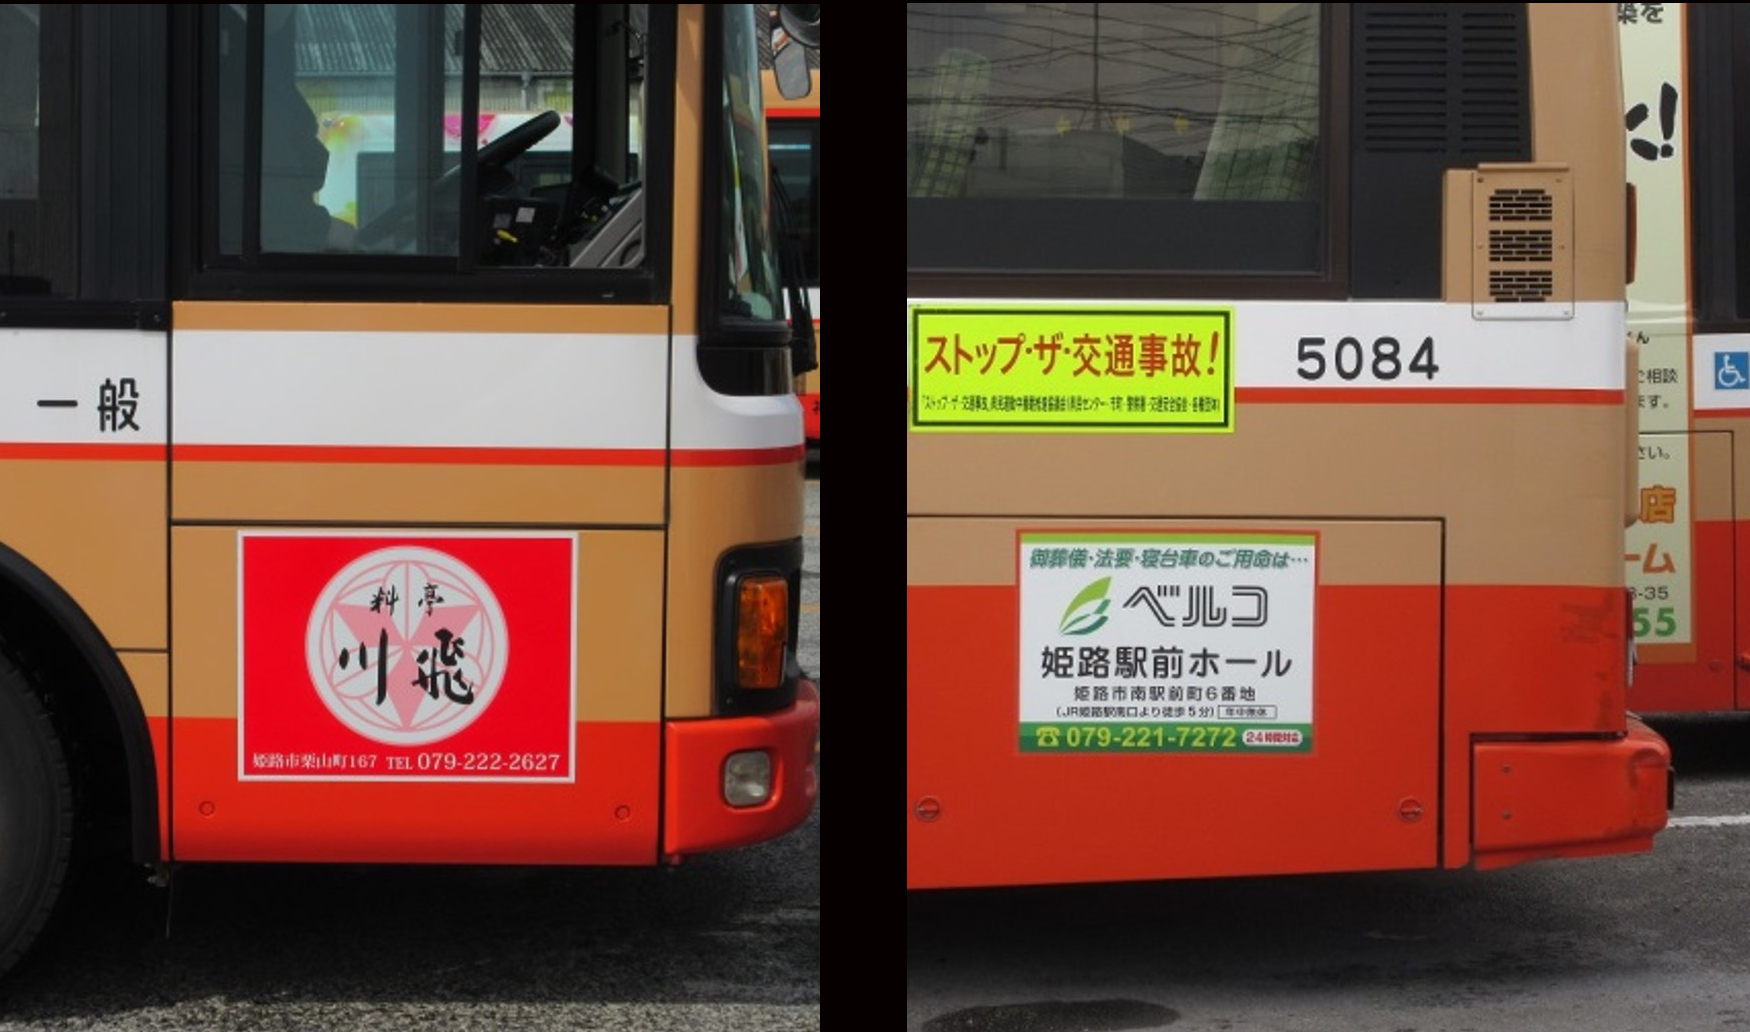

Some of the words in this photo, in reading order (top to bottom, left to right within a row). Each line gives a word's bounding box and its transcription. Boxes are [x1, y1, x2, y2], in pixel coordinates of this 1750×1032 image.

[924, 331, 1219, 377] ストップ・ザ・交通事故!
[1297, 336, 1439, 380] 5084
[37, 377, 140, 432] 一般
[1640, 484, 1677, 524] 店
[370, 583, 444, 616] 料亭
[1122, 585, 1268, 628] ベルコ
[338, 627, 475, 706] 川飛
[1041, 646, 1293, 680] 姫路駅前ホール
[1074, 685, 1257, 703] 姫路市南駅前町6番地
[1066, 727, 1237, 748] 079-221-7272
[386, 758, 413, 770] TEL
[417, 752, 561, 771] 079-222-2627
